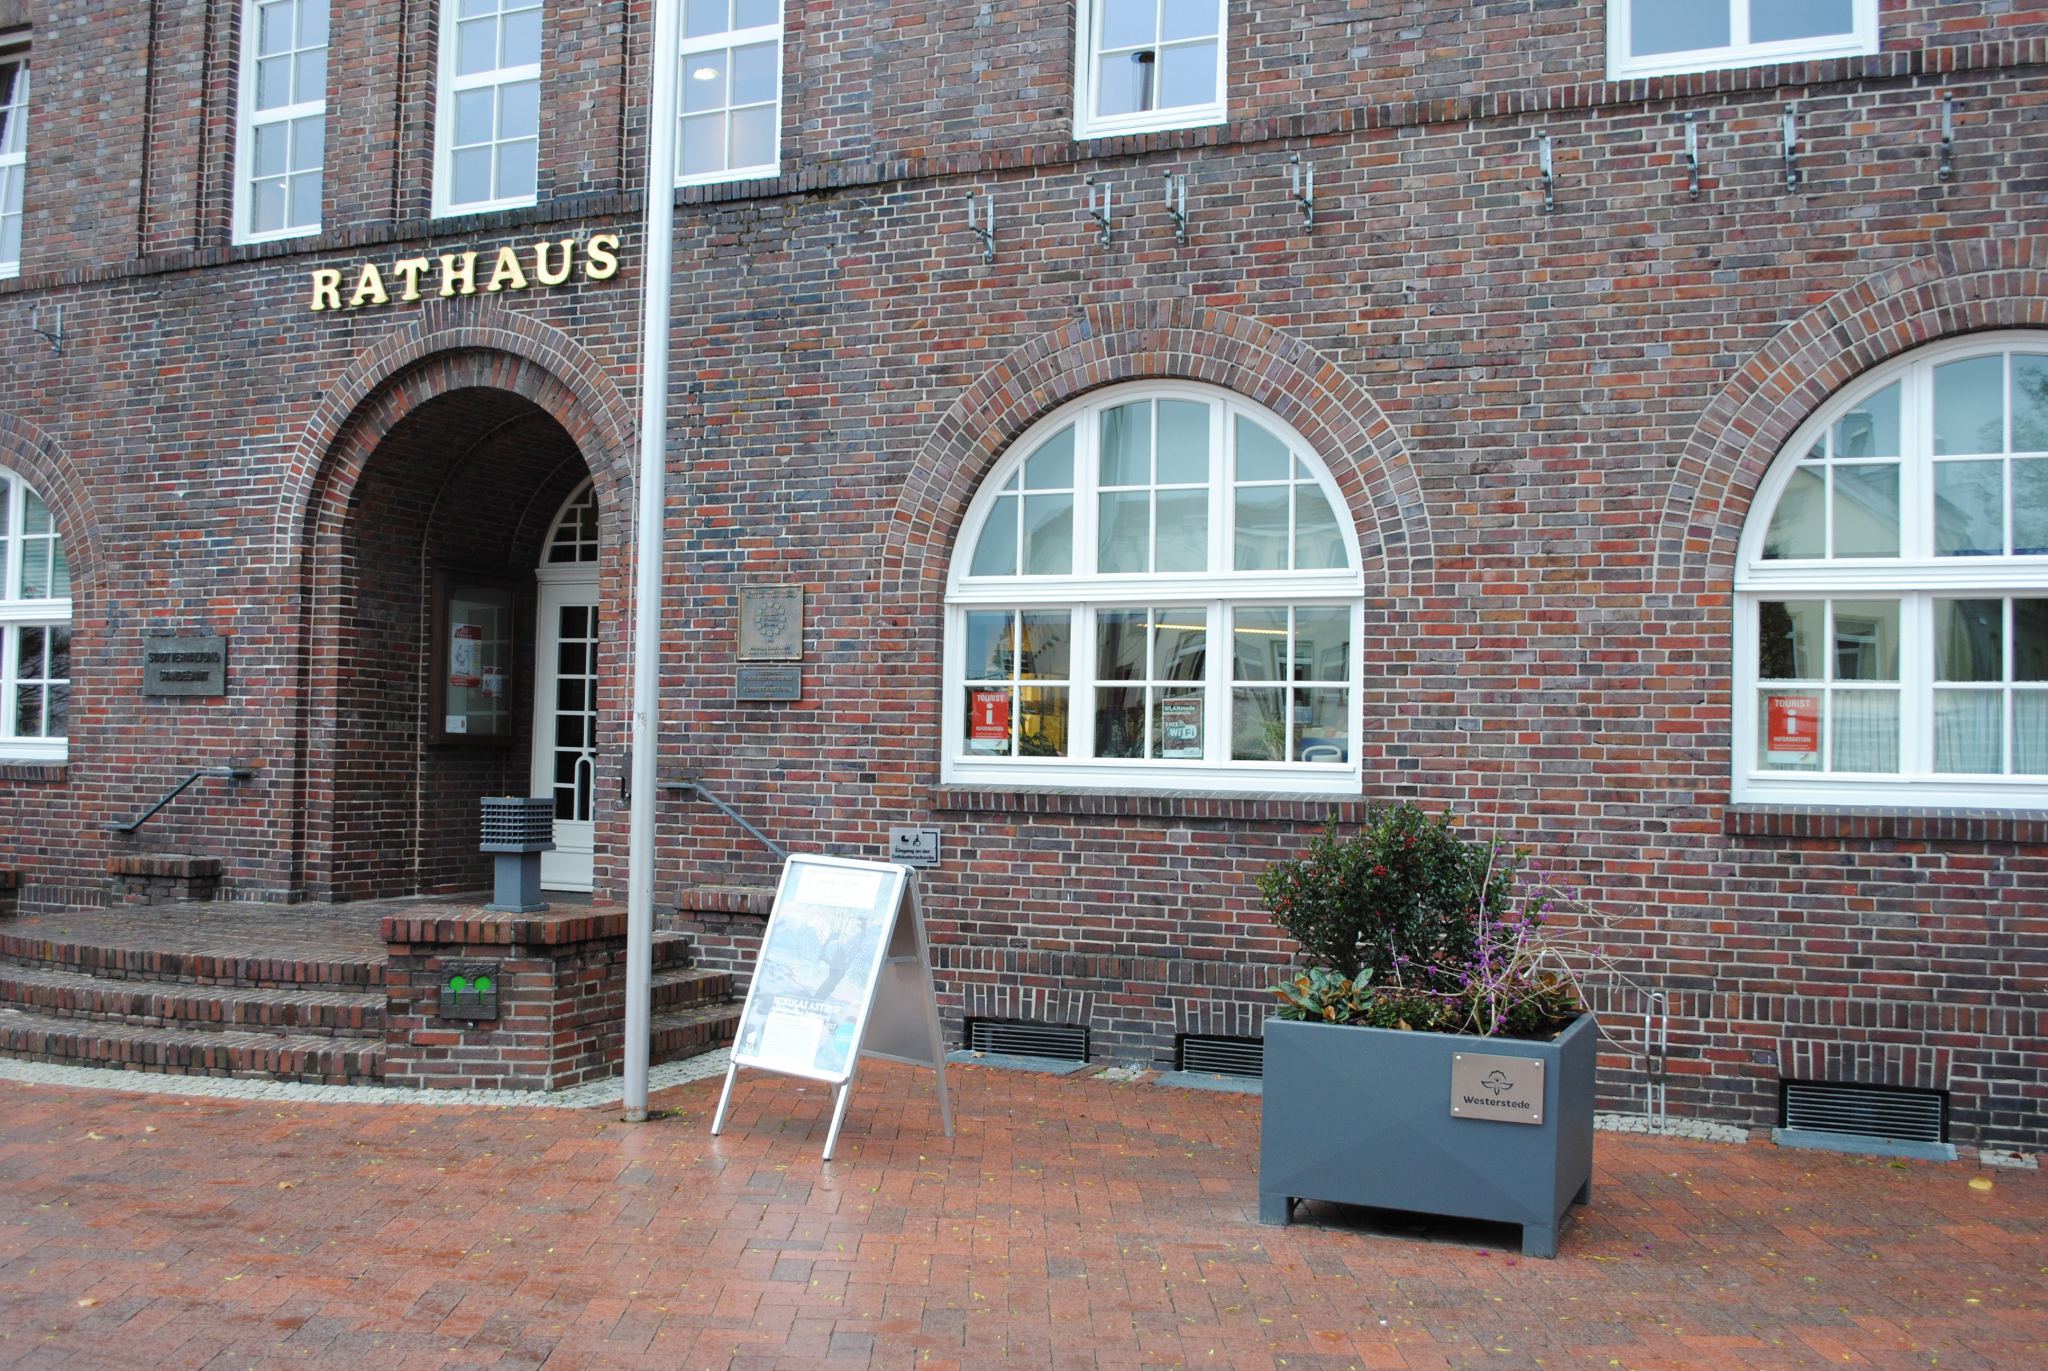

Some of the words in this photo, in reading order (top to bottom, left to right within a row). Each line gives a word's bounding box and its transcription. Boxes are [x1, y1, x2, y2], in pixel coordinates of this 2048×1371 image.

[311, 234, 620, 311] RATHAUS
[977, 694, 1004, 702] TOURIST
[1774, 699, 1810, 707] TOURIST
[1463, 1095, 1530, 1109] Westerstede
